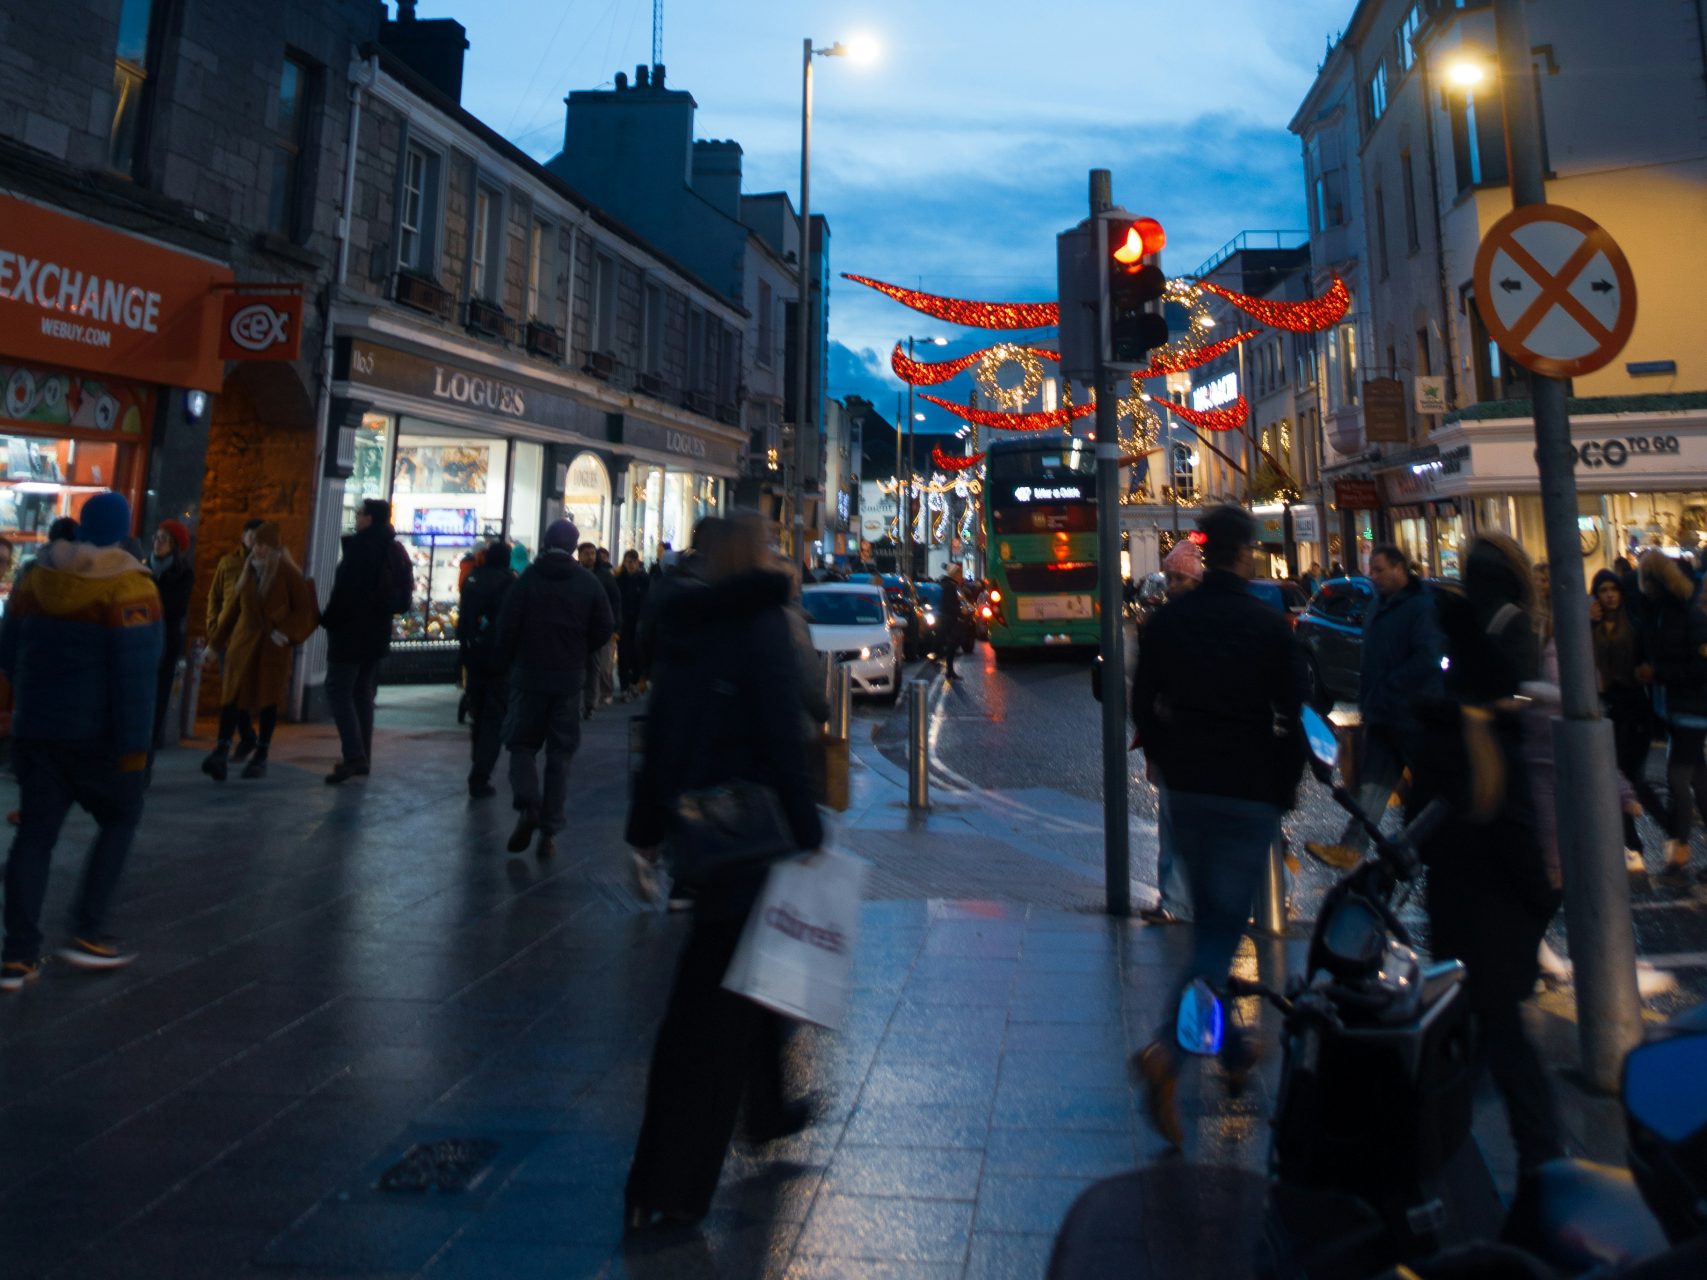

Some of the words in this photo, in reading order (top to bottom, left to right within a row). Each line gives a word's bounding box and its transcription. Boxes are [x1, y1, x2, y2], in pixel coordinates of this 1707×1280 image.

[0, 250, 161, 333] EXCHANGE
[432, 367, 526, 417] LOGUES
[665, 430, 706, 457] LOGUES
[1652, 435, 1679, 451] GO
